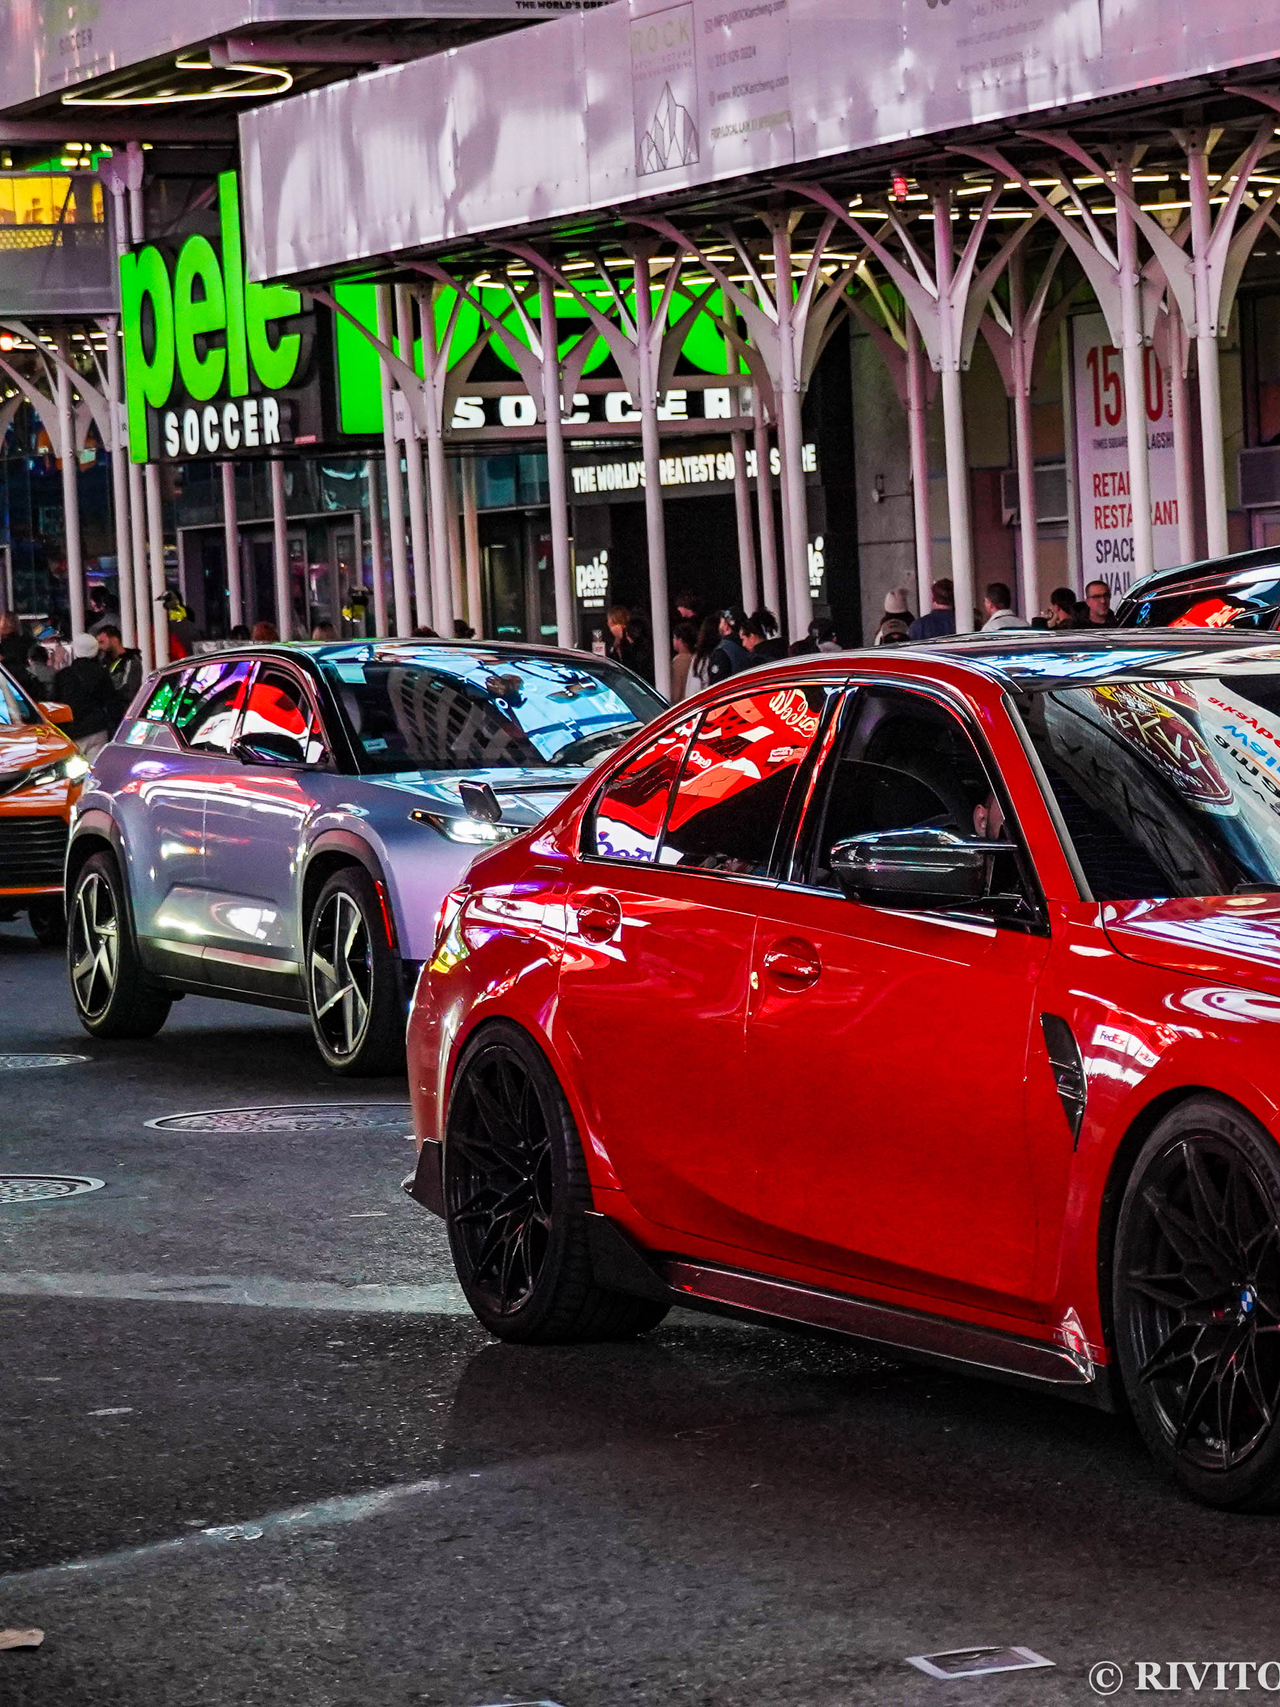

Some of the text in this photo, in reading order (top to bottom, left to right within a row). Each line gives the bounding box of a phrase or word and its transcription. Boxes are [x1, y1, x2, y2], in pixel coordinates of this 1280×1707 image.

[1086, 344, 1164, 428] 150
[165, 397, 281, 458] SOCCER
[571, 466, 597, 494] THE
[659, 452, 716, 486] REATEST
[1092, 471, 1131, 498] RETAI
